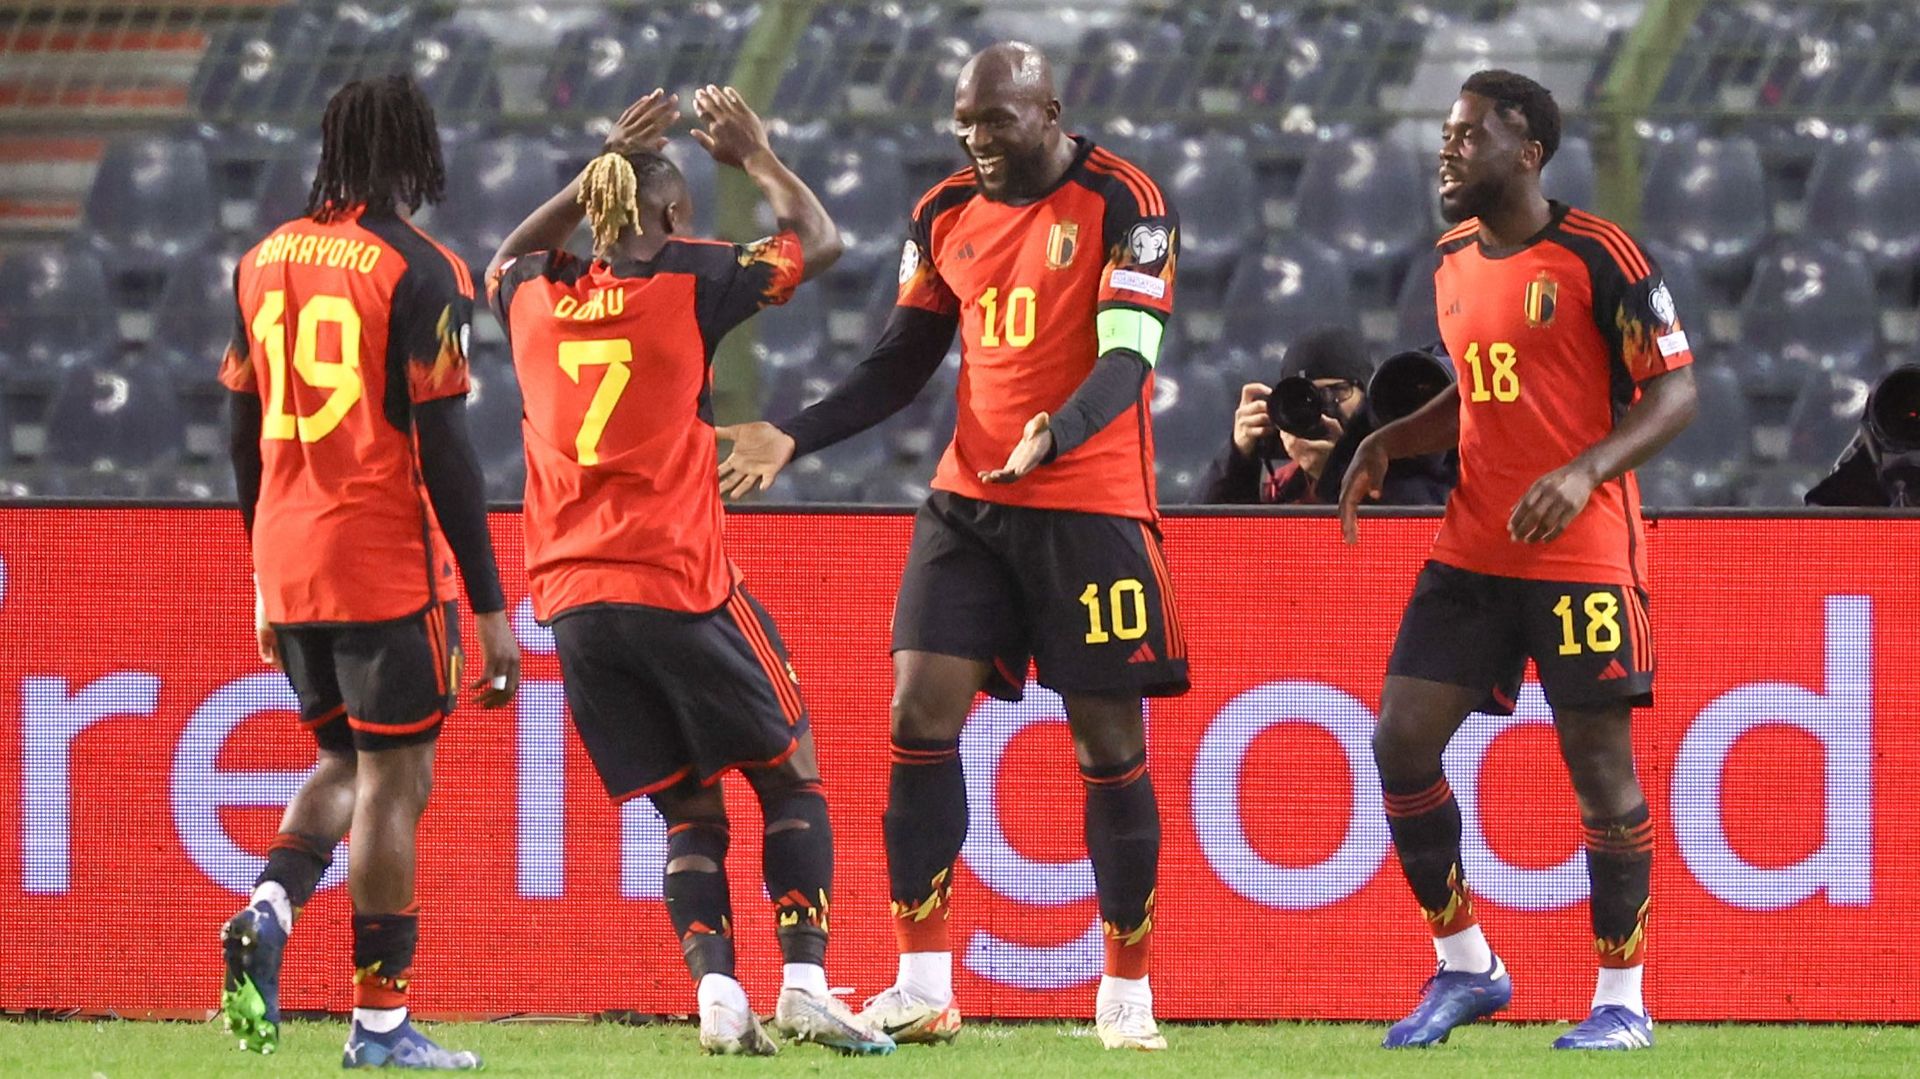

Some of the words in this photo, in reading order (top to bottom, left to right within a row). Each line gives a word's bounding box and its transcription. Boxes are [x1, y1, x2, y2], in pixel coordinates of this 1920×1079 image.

[255, 232, 381, 274] BAKAYOKO
[554, 287, 624, 320] DOKU
[979, 286, 1036, 348] 10
[252, 289, 362, 443] 19
[1464, 342, 1520, 402] 18
[558, 338, 632, 466] 7
[1079, 578, 1147, 644] 10
[1553, 592, 1622, 656] 18
